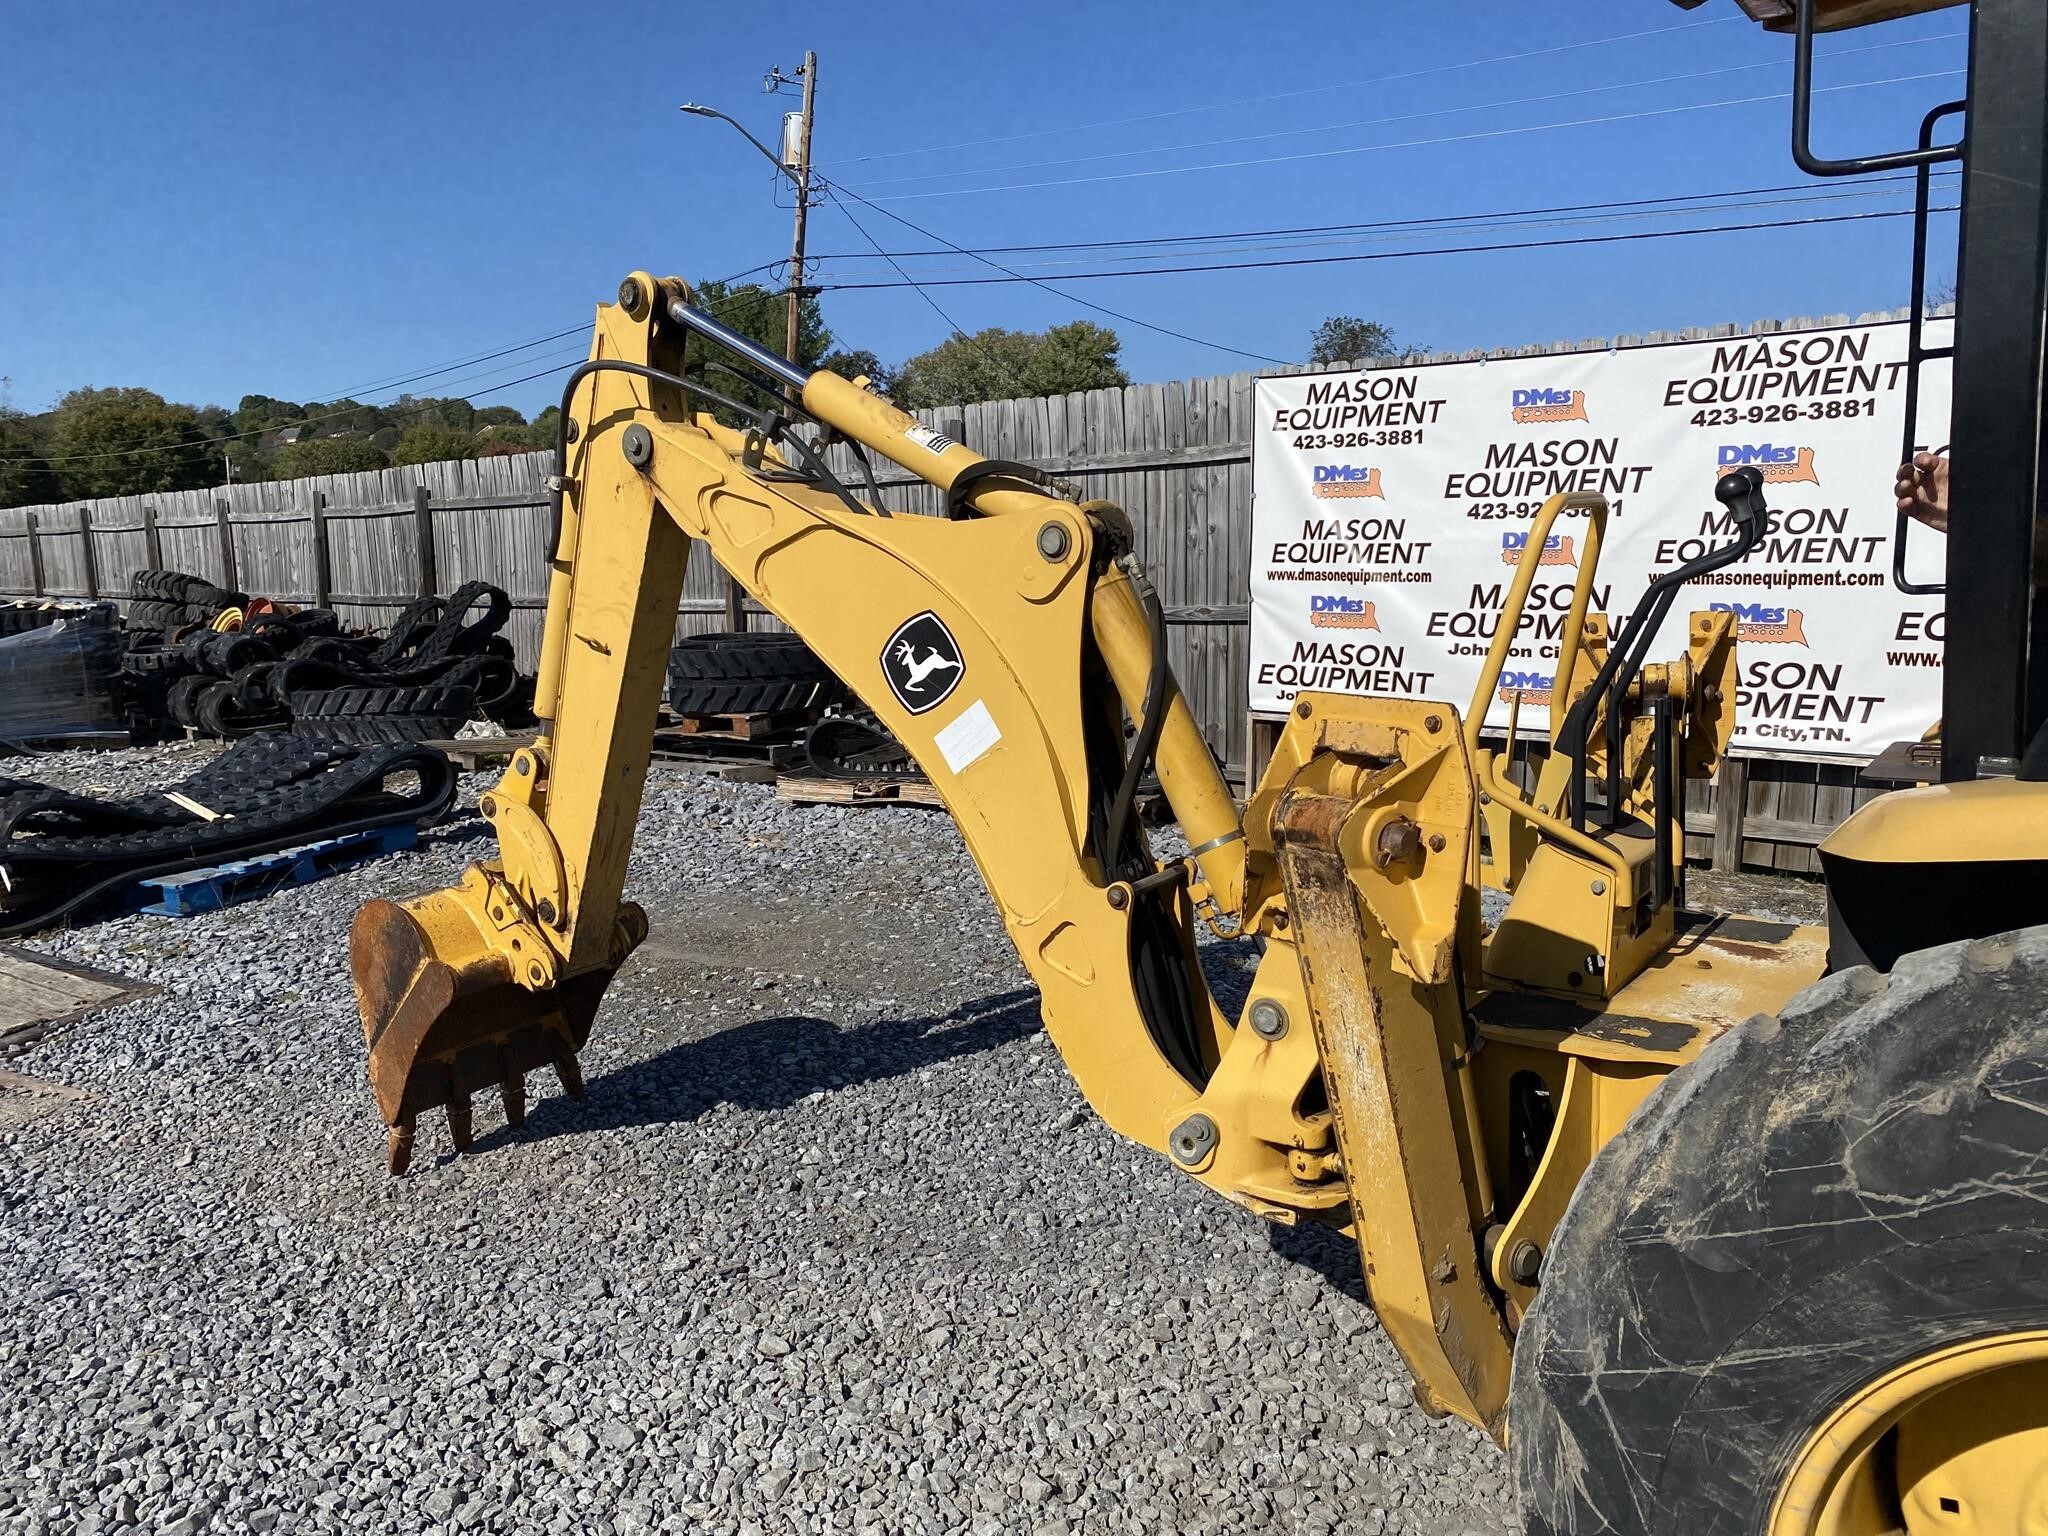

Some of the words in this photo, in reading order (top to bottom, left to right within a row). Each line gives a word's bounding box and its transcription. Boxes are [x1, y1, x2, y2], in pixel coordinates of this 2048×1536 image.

[1711, 333, 1870, 373] MASON
[1306, 376, 1418, 405] MASON
[1663, 361, 1909, 406] EQUIPMENT
[1272, 400, 1447, 431] EQUIPMENT
[1690, 398, 1876, 427] 423-926-3881
[1293, 429, 1423, 450] 423-926-3881
[1484, 437, 1619, 469] MASON
[1444, 466, 1653, 498] EQUIPMENT
[1302, 519, 1406, 540] MASON
[1699, 508, 1849, 535] MSON
[1271, 543, 1432, 564] EQUIPMENT
[1267, 568, 1432, 585] www.dmasonequipment.com
[1469, 584, 1611, 610] MSON
[1292, 641, 1405, 668] MASON
[1257, 664, 1435, 694] EQUIPMENT
[1736, 661, 1842, 691] SON
[1755, 724, 1851, 742] City,TN.
